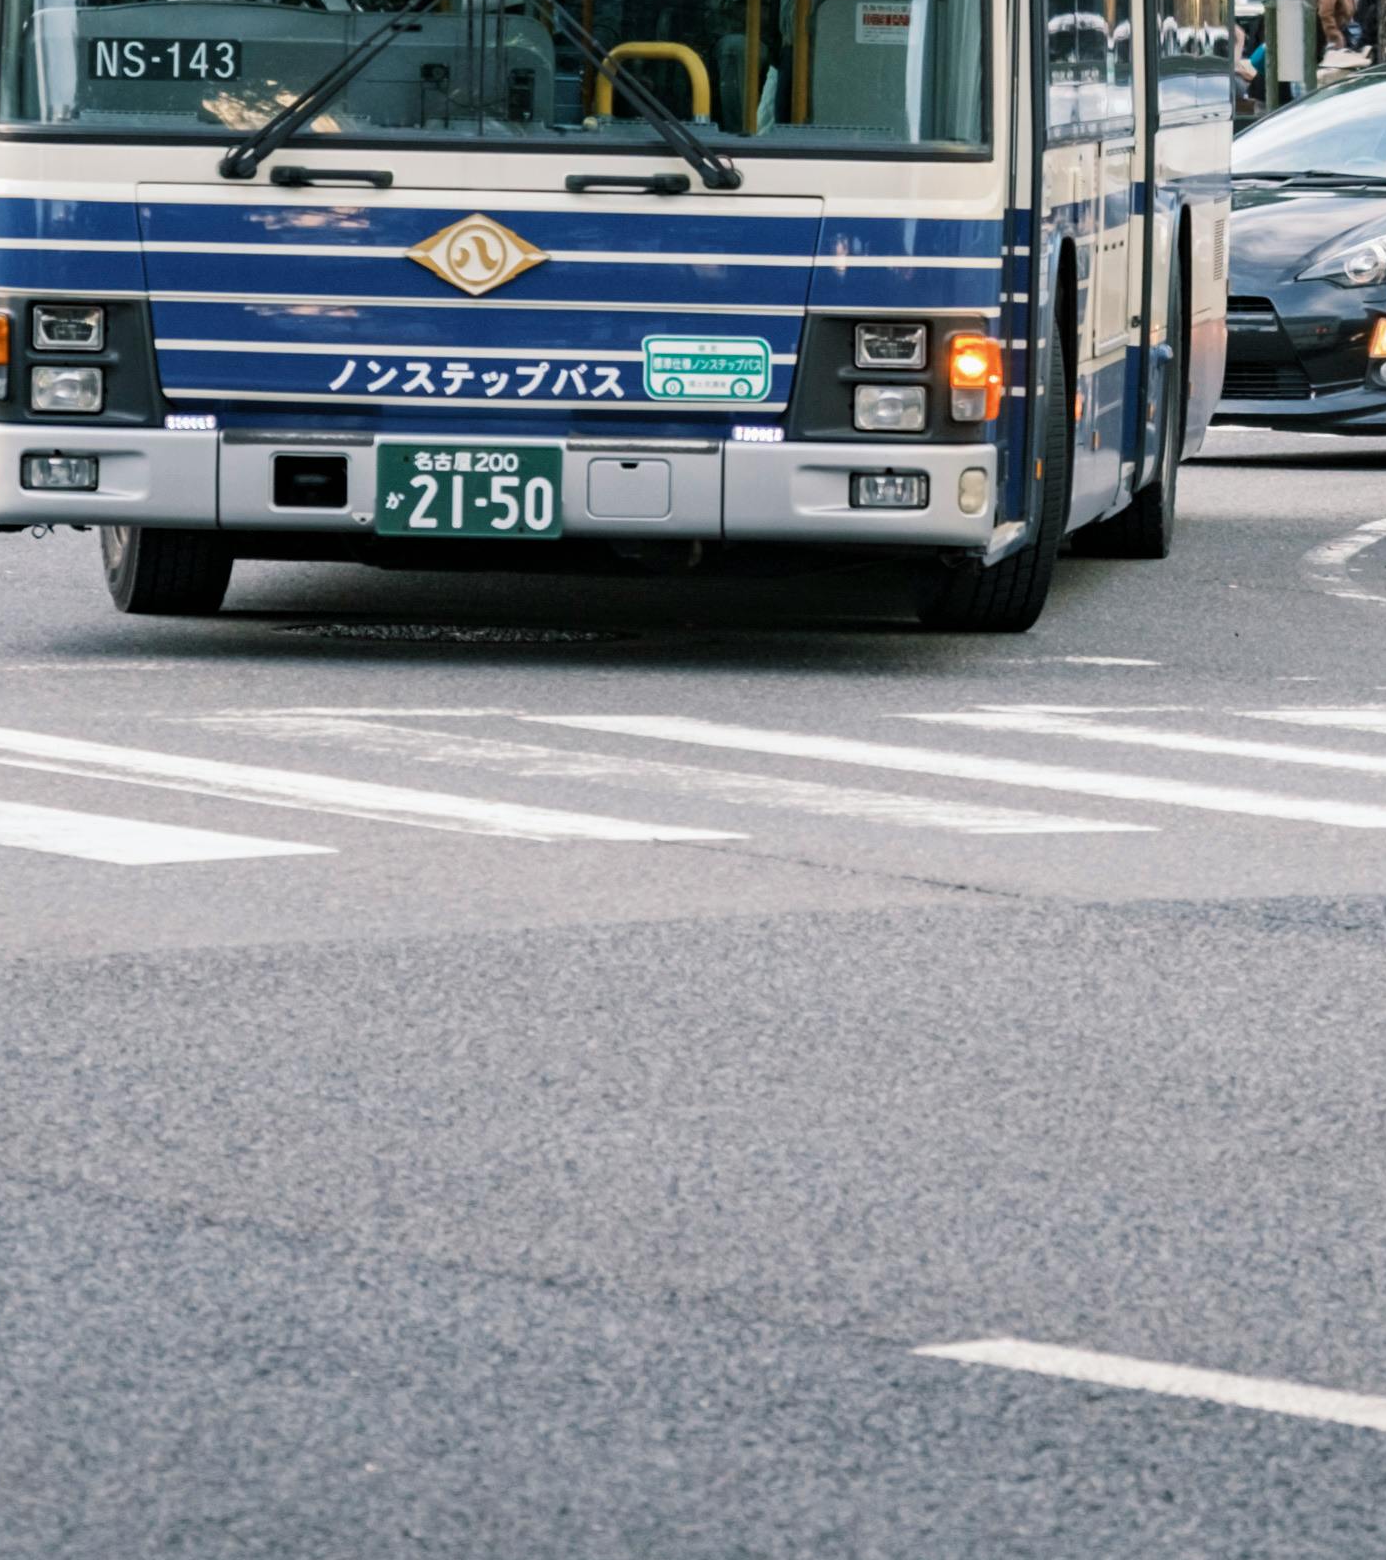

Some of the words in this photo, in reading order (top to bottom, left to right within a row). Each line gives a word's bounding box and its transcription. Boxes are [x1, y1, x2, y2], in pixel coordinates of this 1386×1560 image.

[96, 40, 235, 78] NS-143
[328, 359, 625, 399] ノンステップバス
[385, 491, 406, 510] か
[409, 474, 554, 531] 21-50
